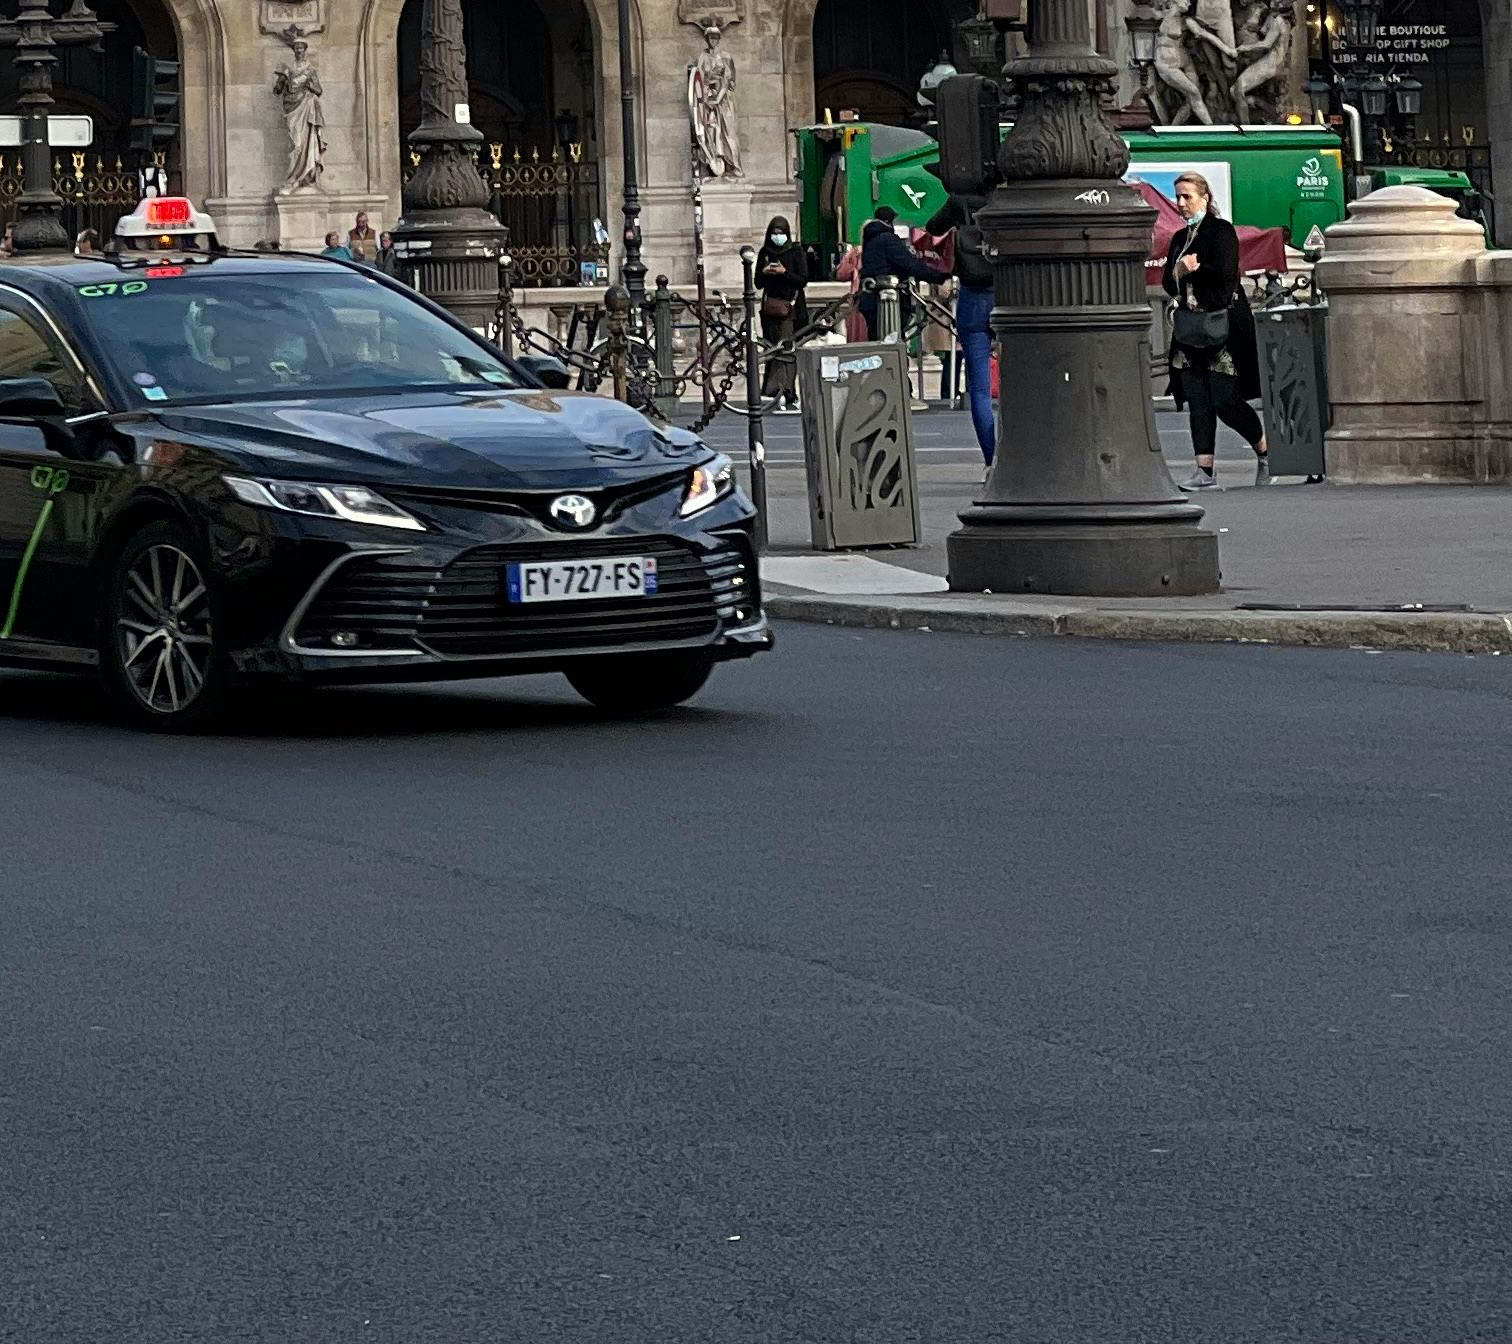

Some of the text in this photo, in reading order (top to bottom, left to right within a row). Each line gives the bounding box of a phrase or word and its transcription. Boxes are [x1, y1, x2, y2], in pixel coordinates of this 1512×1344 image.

[1389, 25, 1446, 35] BOUTIQUE
[1393, 40, 1417, 49] GIFT
[1420, 38, 1450, 49] SHOP
[1388, 53, 1429, 63] TIENDA
[1296, 176, 1329, 187] PARIS
[525, 562, 641, 596] FY-727-FS
